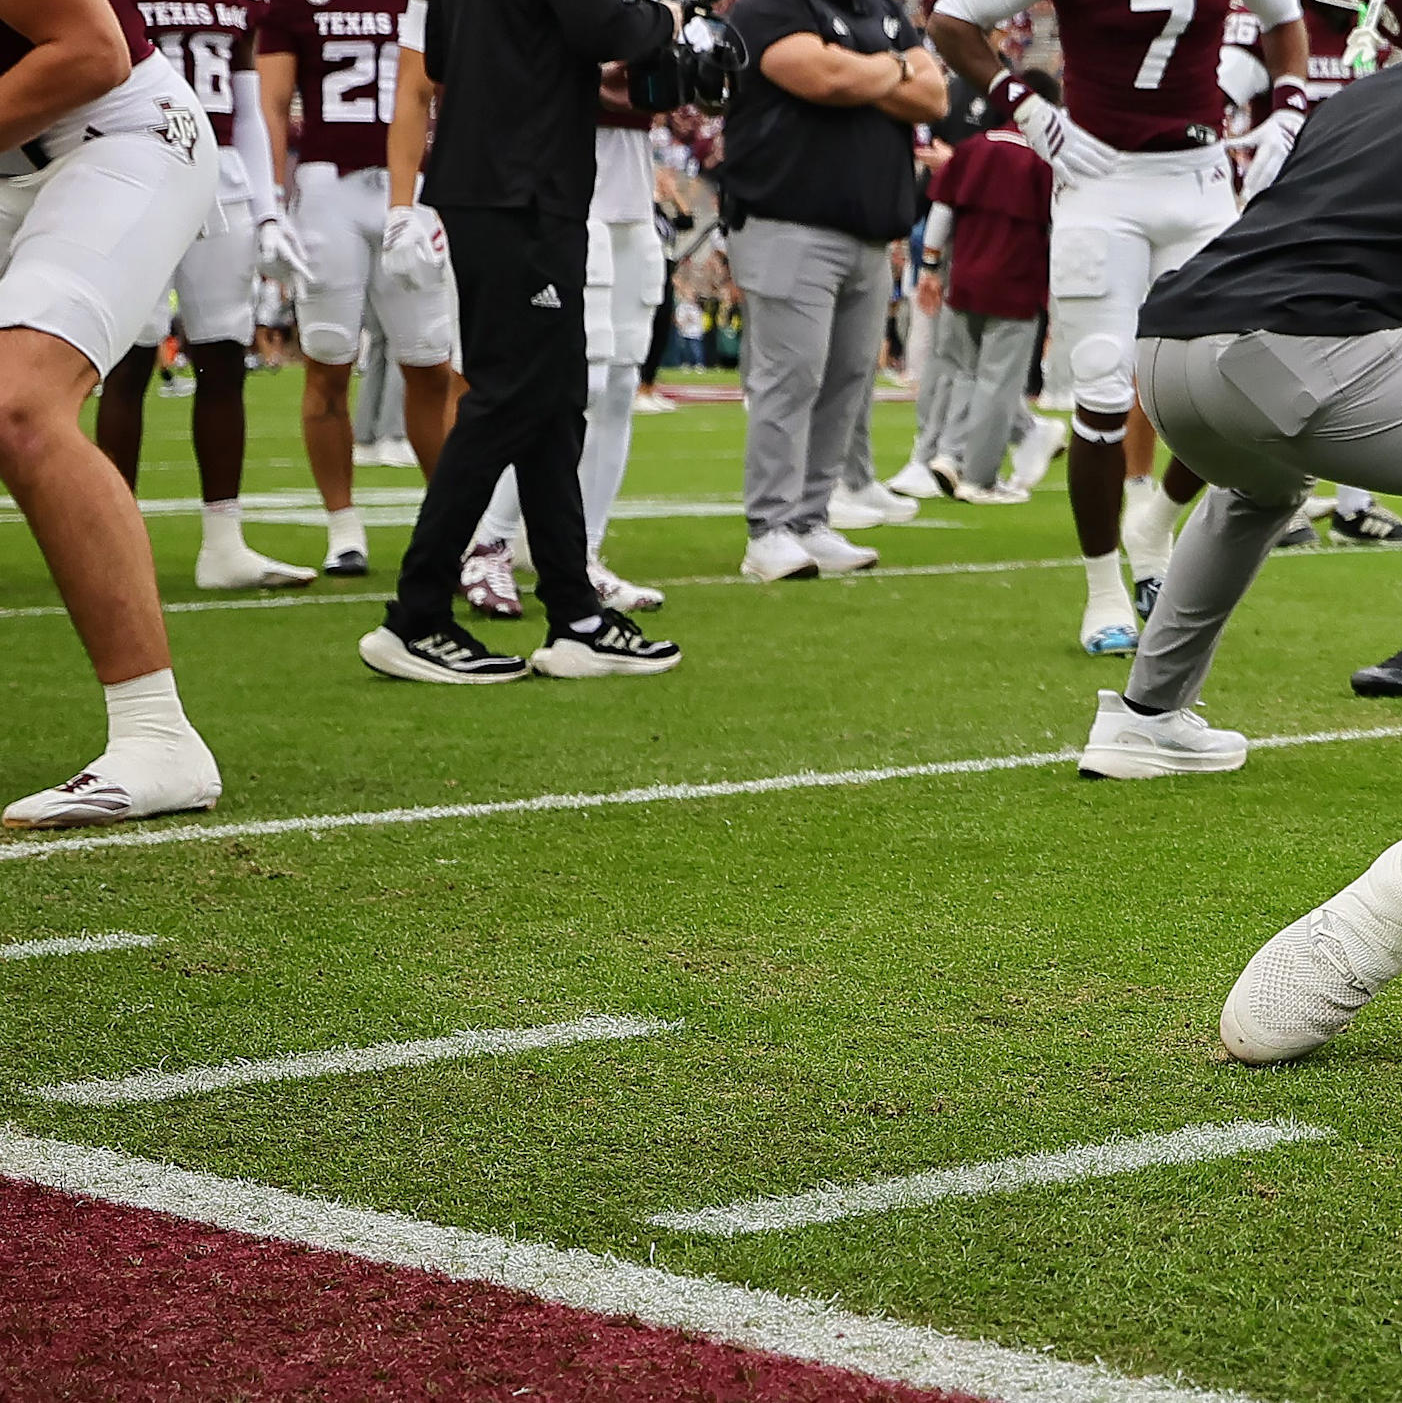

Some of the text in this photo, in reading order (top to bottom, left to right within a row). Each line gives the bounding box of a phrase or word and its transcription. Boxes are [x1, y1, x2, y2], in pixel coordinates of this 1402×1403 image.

[137, 1, 214, 27] TEXAS
[313, 11, 393, 36] TEXAS
[156, 31, 235, 115] 16
